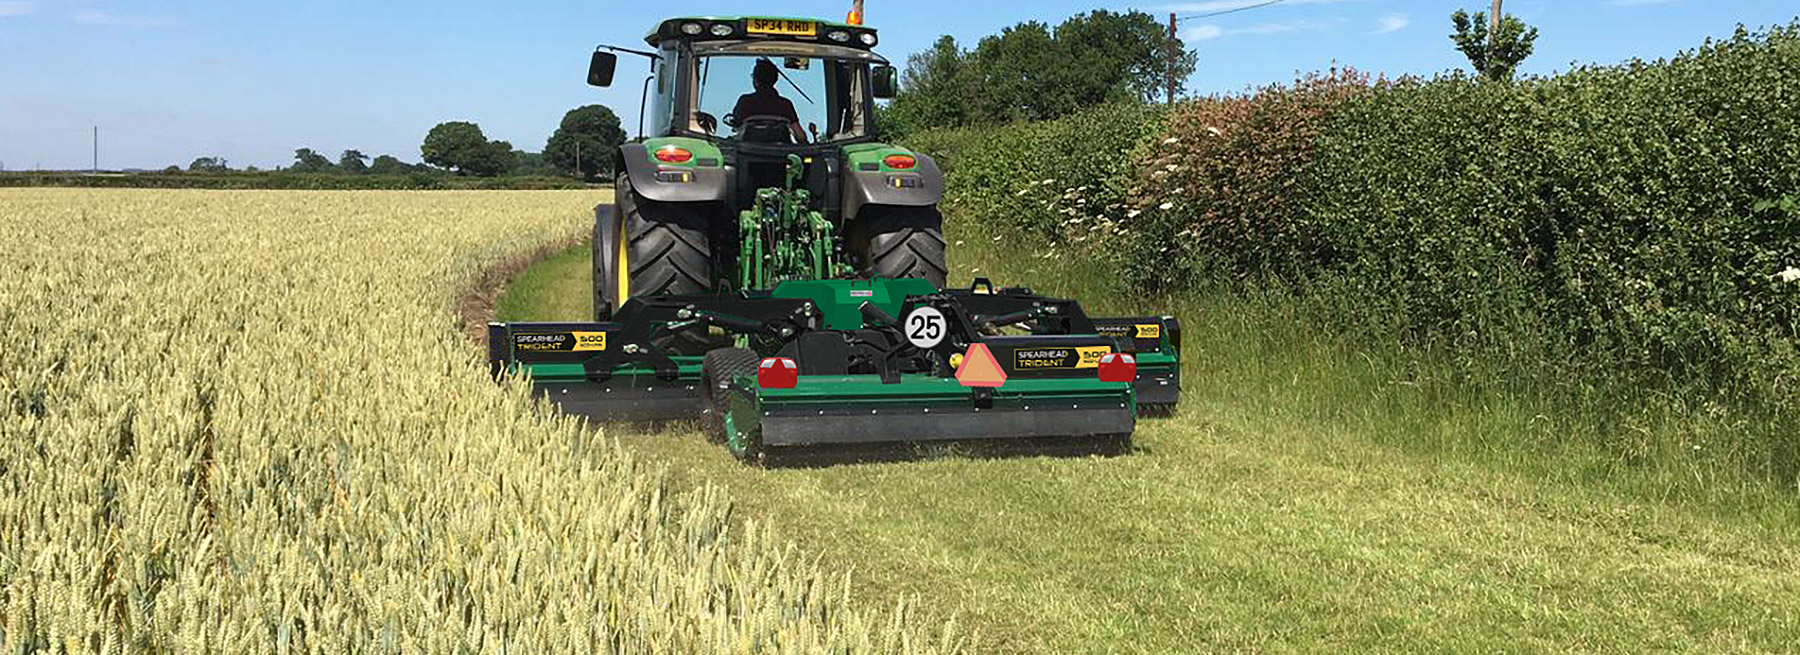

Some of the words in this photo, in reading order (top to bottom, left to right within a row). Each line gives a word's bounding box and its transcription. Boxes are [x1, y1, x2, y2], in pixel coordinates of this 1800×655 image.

[754, 19, 782, 31] SP34
[787, 21, 809, 32] RHD
[911, 315, 941, 340] 25
[517, 335, 566, 343] SPEARHEAD
[517, 342, 562, 350] TRIDENT
[1018, 350, 1069, 359] SPEARHEAD
[1018, 358, 1065, 368] TRIDENT
